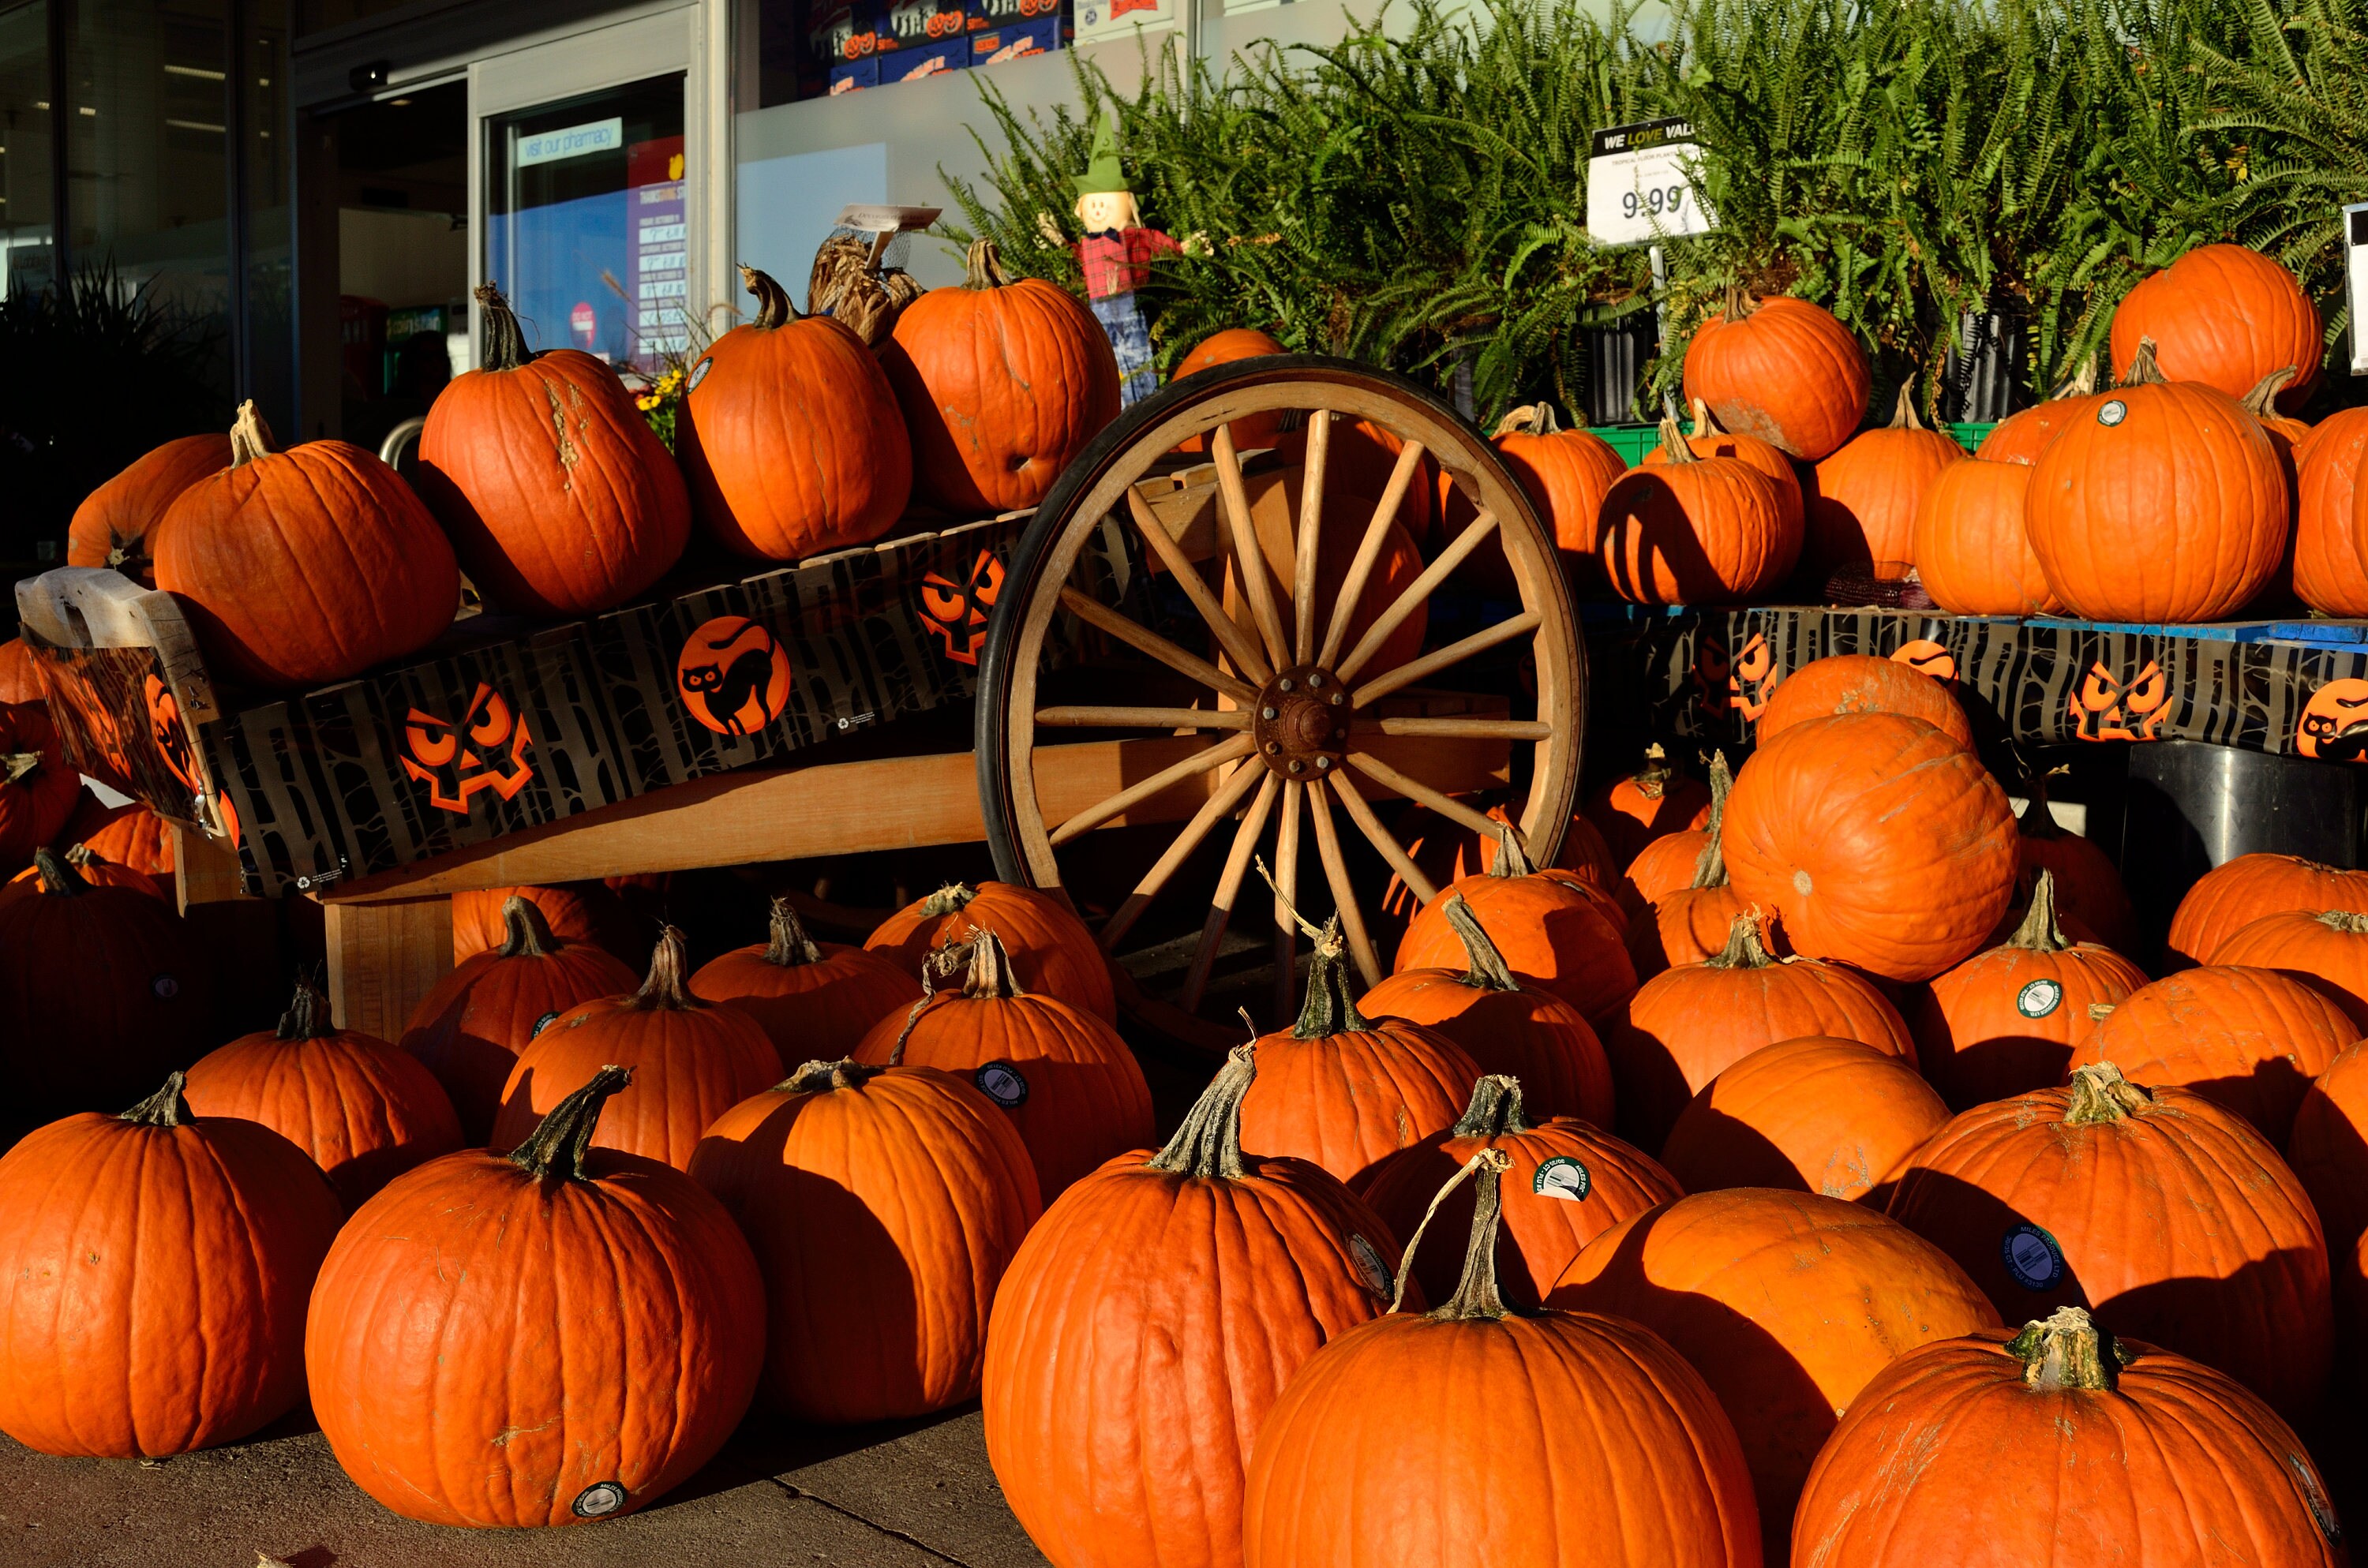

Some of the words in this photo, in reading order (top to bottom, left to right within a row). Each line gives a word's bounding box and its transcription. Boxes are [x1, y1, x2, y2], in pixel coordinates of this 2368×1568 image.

[526, 138, 541, 157] visit
[545, 138, 560, 154] our
[564, 127, 613, 154] pharmacy
[1605, 134, 1625, 149] WE
[1628, 129, 1663, 145] LOVE
[1665, 123, 1695, 139] VAL
[1622, 185, 1682, 219] 9.99
[1575, 1165, 1587, 1181] MILES
[2021, 1226, 2041, 1237] MILES
[2041, 1234, 2060, 1264] PRODUCE
[2005, 1255, 2013, 1263] CT
[2012, 1267, 2025, 1280] PLU
[2024, 1278, 2044, 1288] #3130
